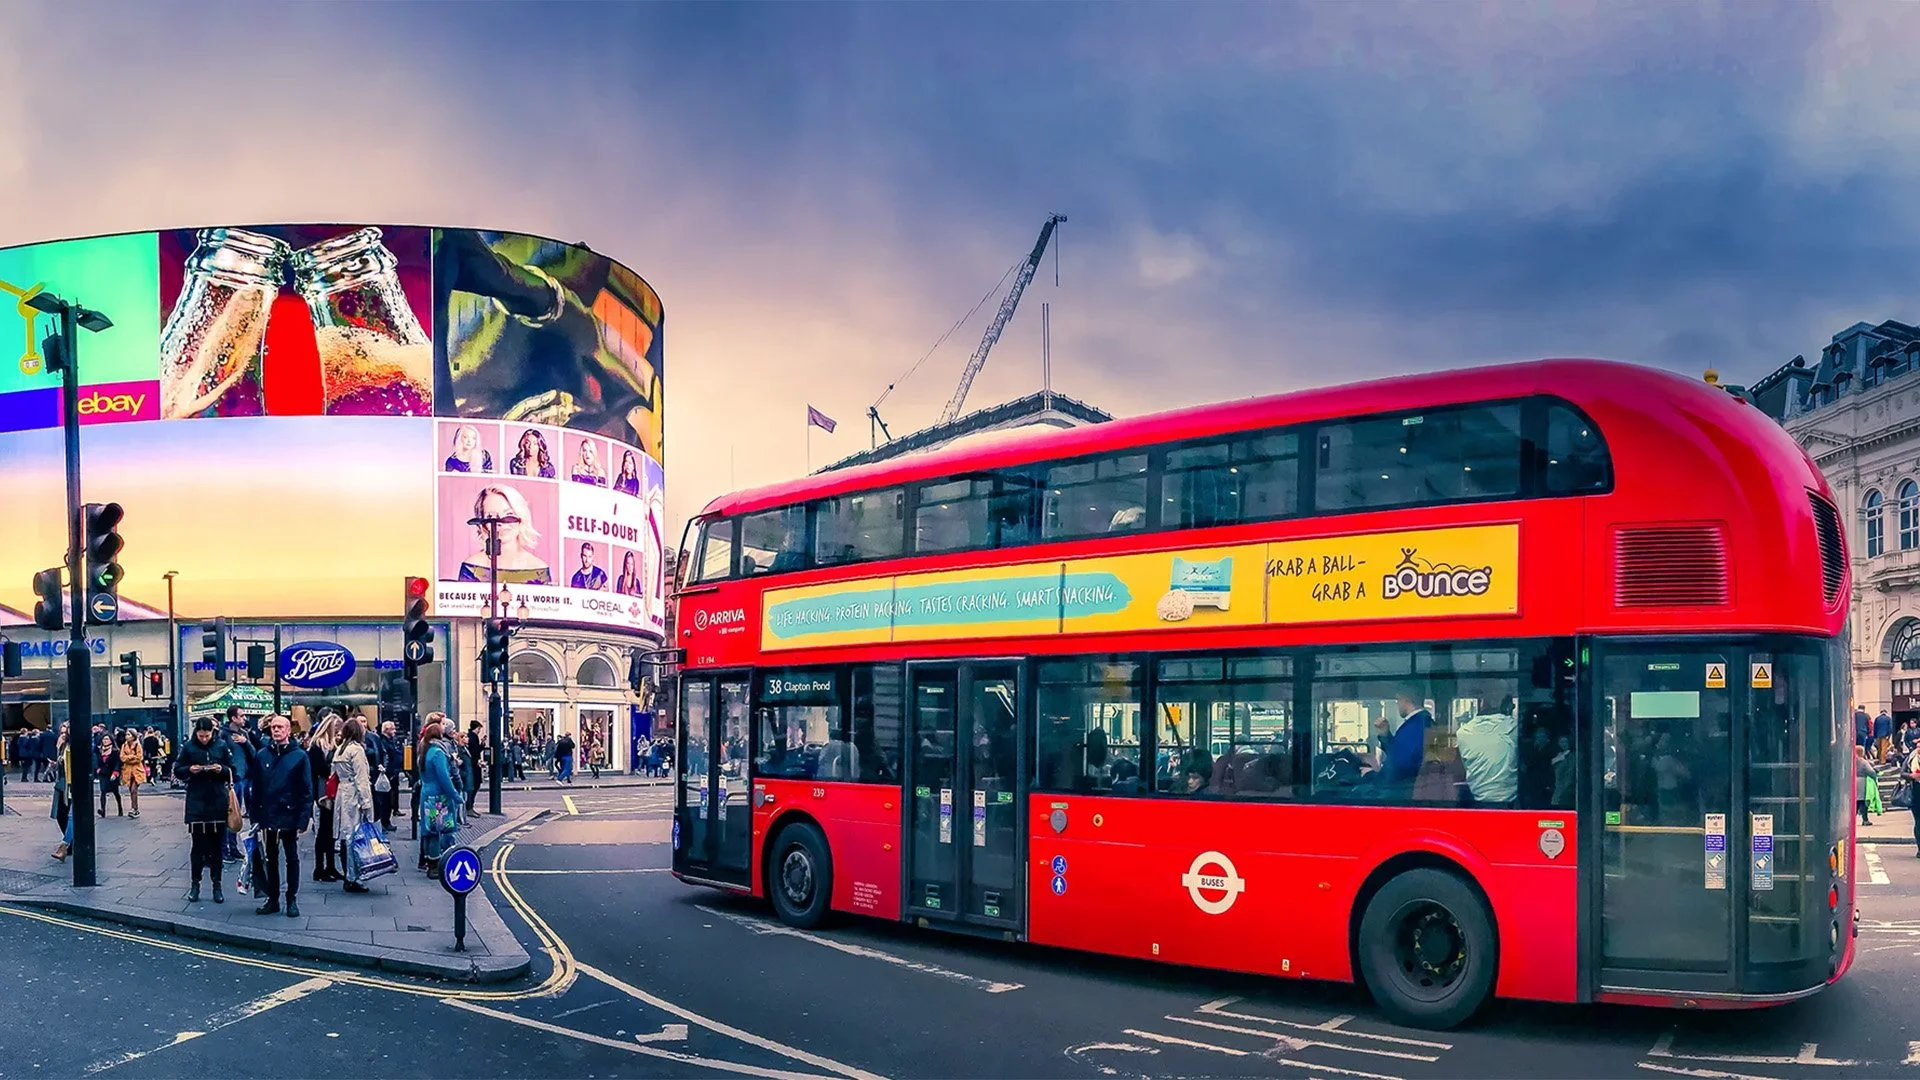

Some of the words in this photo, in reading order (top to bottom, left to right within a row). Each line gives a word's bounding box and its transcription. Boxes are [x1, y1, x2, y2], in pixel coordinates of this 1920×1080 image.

[78, 392, 145, 416] ebay
[613, 503, 617, 515] I
[568, 515, 638, 542] SELF-DOUBT
[1266, 559, 1304, 577] GRAB
[1307, 558, 1316, 575] A
[439, 592, 476, 601] BECAUSE
[533, 596, 560, 605] WORTH
[1312, 582, 1351, 602] GRAB
[1356, 581, 1366, 598] A
[776, 610, 793, 627] LIFE
[836, 602, 869, 620] PROTEIN
[920, 594, 952, 614] TASTES
[956, 591, 1010, 613] CRACKING.
[1016, 587, 1054, 608] SMART
[709, 608, 745, 625] ARRIVA
[285, 649, 346, 680] Boots
[769, 679, 782, 695] 38
[784, 681, 810, 693] Clapton
[812, 680, 831, 691] Pond
[813, 787, 825, 798] 239
[1201, 877, 1225, 888] BUSES
